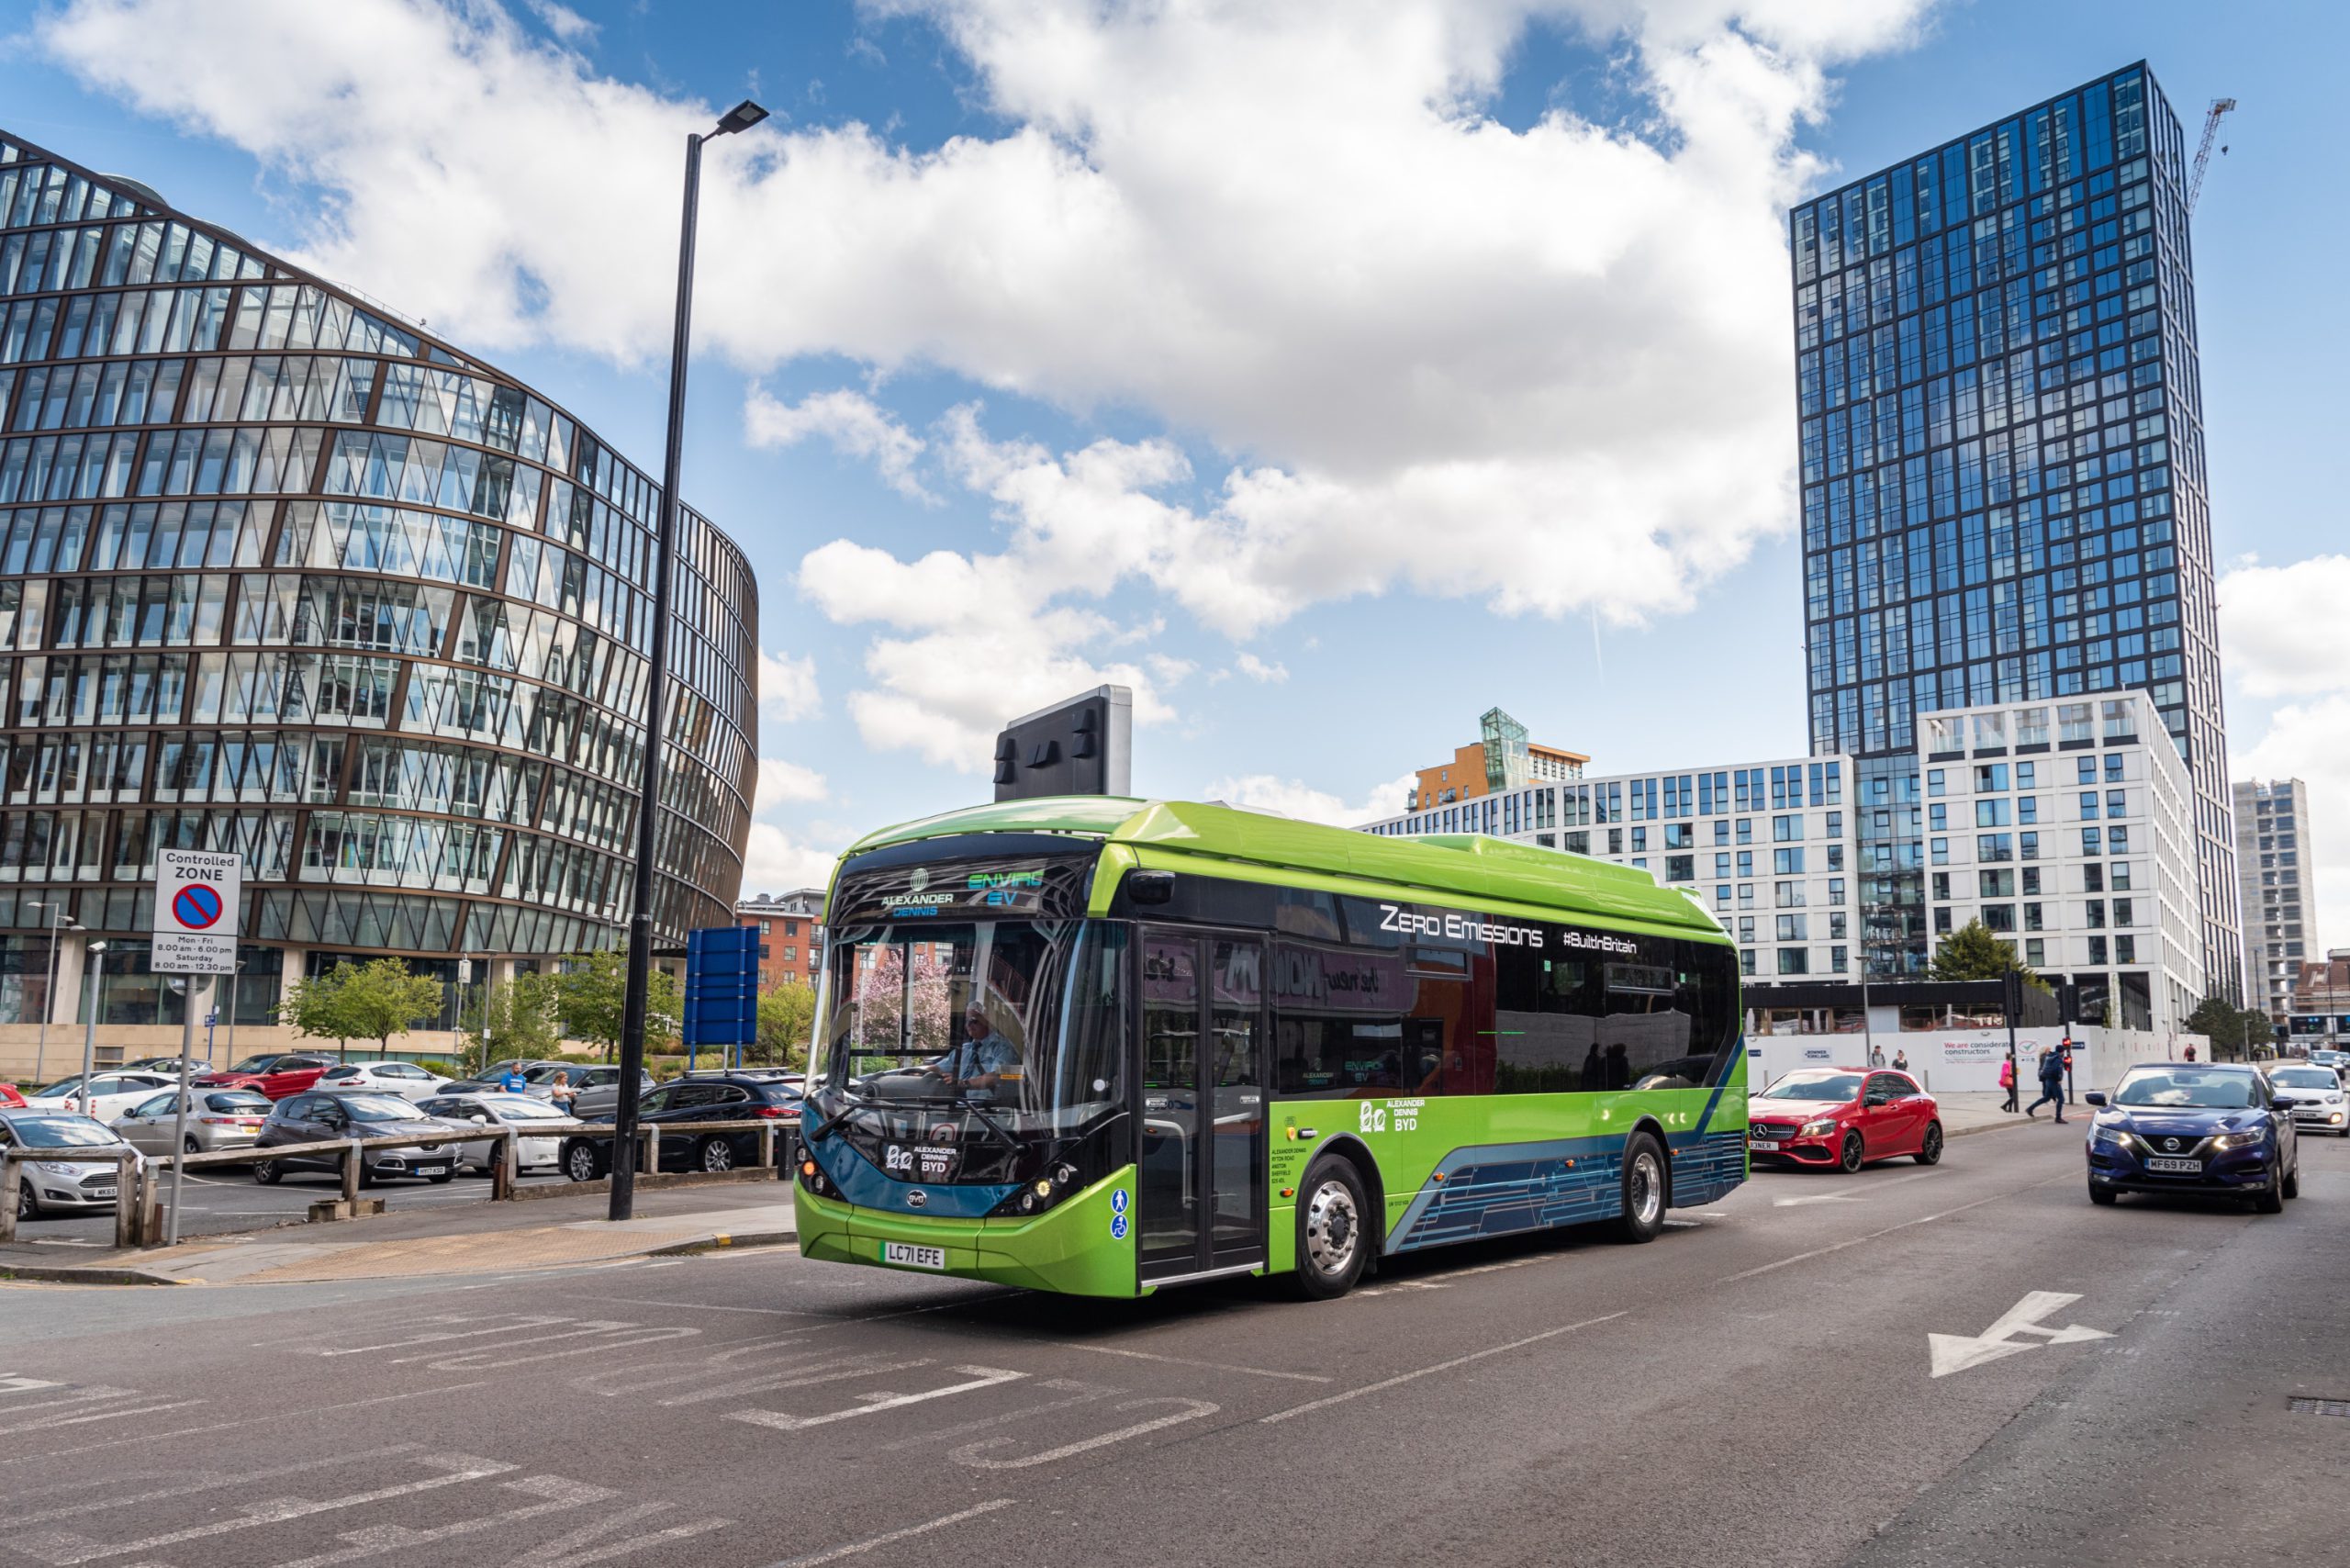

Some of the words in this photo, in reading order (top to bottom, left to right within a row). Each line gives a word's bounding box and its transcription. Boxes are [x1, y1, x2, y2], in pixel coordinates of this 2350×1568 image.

[166, 853, 235, 867] Controlled
[175, 867, 224, 880] ZONE
[881, 893, 954, 906] ALEXANDER
[988, 890, 1017, 906] EV
[892, 906, 938, 917] DENNIS
[157, 944, 178, 952] 8.00
[176, 954, 213, 963] Saturday
[196, 963, 218, 971] 12.30
[1386, 1099, 1425, 1108] ALEXANDER
[1393, 1107, 1418, 1116] DENNIS
[1395, 1118, 1416, 1131] BYD
[913, 1147, 957, 1155] ALEXANDER
[921, 1153, 948, 1161] DENNIS
[922, 1161, 946, 1172] BYD
[2151, 1159, 2177, 1169] MF69
[2179, 1160, 2200, 1170] PZH
[908, 1194, 924, 1203] BYD
[890, 1244, 914, 1261] LC71
[917, 1248, 940, 1265] EFE
